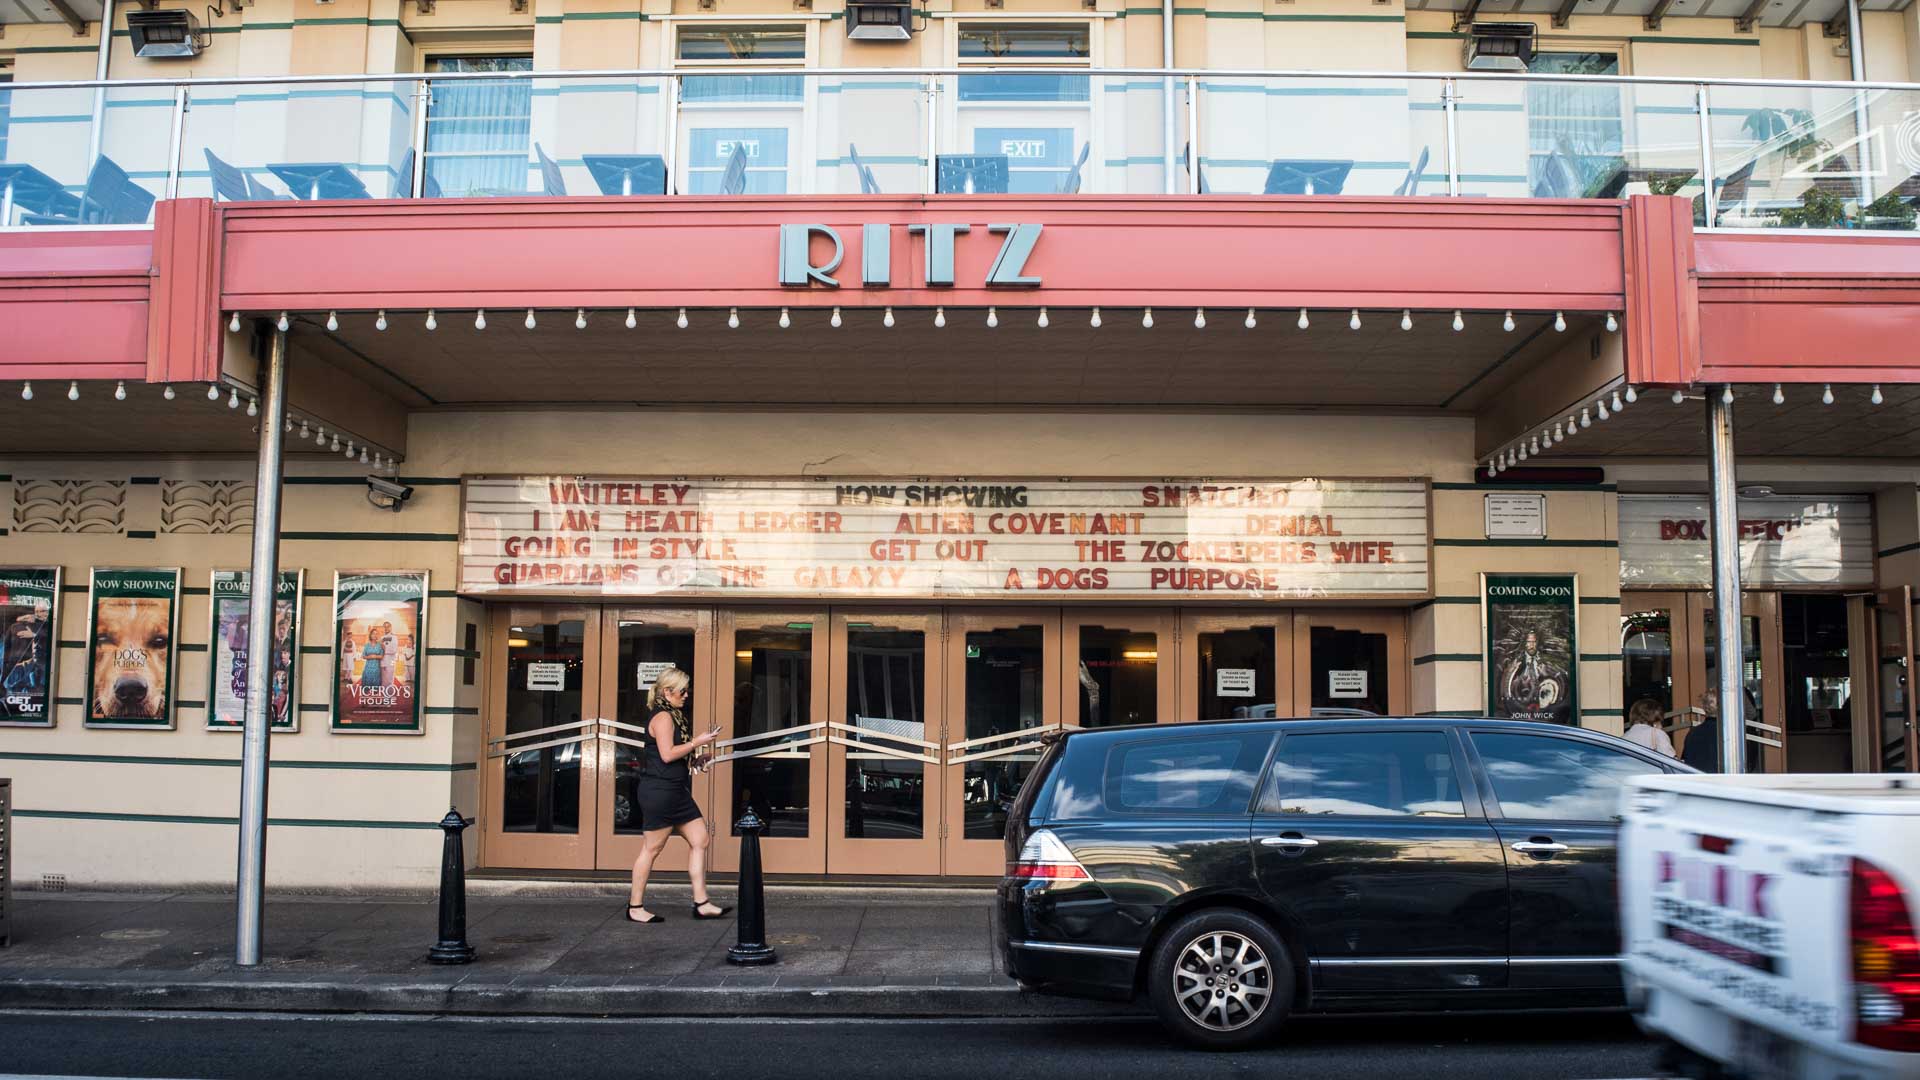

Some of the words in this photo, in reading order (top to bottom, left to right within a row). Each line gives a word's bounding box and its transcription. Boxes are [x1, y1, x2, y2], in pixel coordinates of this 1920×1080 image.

[718, 142, 756, 157] EIT
[1003, 142, 1042, 157] EXIT
[779, 223, 1043, 288] RITZ
[549, 483, 690, 506] WHITELEY
[836, 485, 897, 506] NOW
[905, 485, 1027, 508] SHOWING
[1142, 485, 1290, 508] SNATCHED
[533, 509, 540, 531] I
[560, 509, 600, 533] AM
[625, 510, 713, 533] HEATH
[738, 510, 842, 534] LEDGER
[895, 512, 975, 535] ALIEN
[988, 512, 1144, 536] COVENANT
[1247, 514, 1342, 537] DENIAL
[1660, 519, 1707, 541] BOX
[504, 536, 591, 558] GOING
[613, 537, 639, 560] IN
[650, 537, 738, 561] STYLE
[870, 538, 921, 561] GET
[936, 539, 988, 562] OUT
[1074, 540, 1126, 562] THE
[1141, 540, 1317, 563] ZOOKEEPERS
[1330, 541, 1395, 564] WIFE
[4, 579, 55, 589] SHOWING
[95, 580, 120, 589] NOW
[122, 580, 175, 590] SHOWING
[217, 581, 251, 592] COMI
[493, 563, 640, 586] GUARDIANS
[717, 565, 767, 588] THE
[793, 566, 906, 588] GALAXY
[1004, 567, 1024, 590] A
[1037, 568, 1109, 590] DOGS
[1150, 568, 1280, 590] PURPOSE
[340, 582, 388, 593] COMING
[389, 583, 420, 593] SOON
[1488, 586, 1537, 596] COMING
[1539, 586, 1571, 596] SOON
[7, 695, 31, 705] GET
[346, 684, 411, 699] VICEROY'S
[359, 697, 398, 705] HOUSE
[19, 703, 44, 712] OUT
